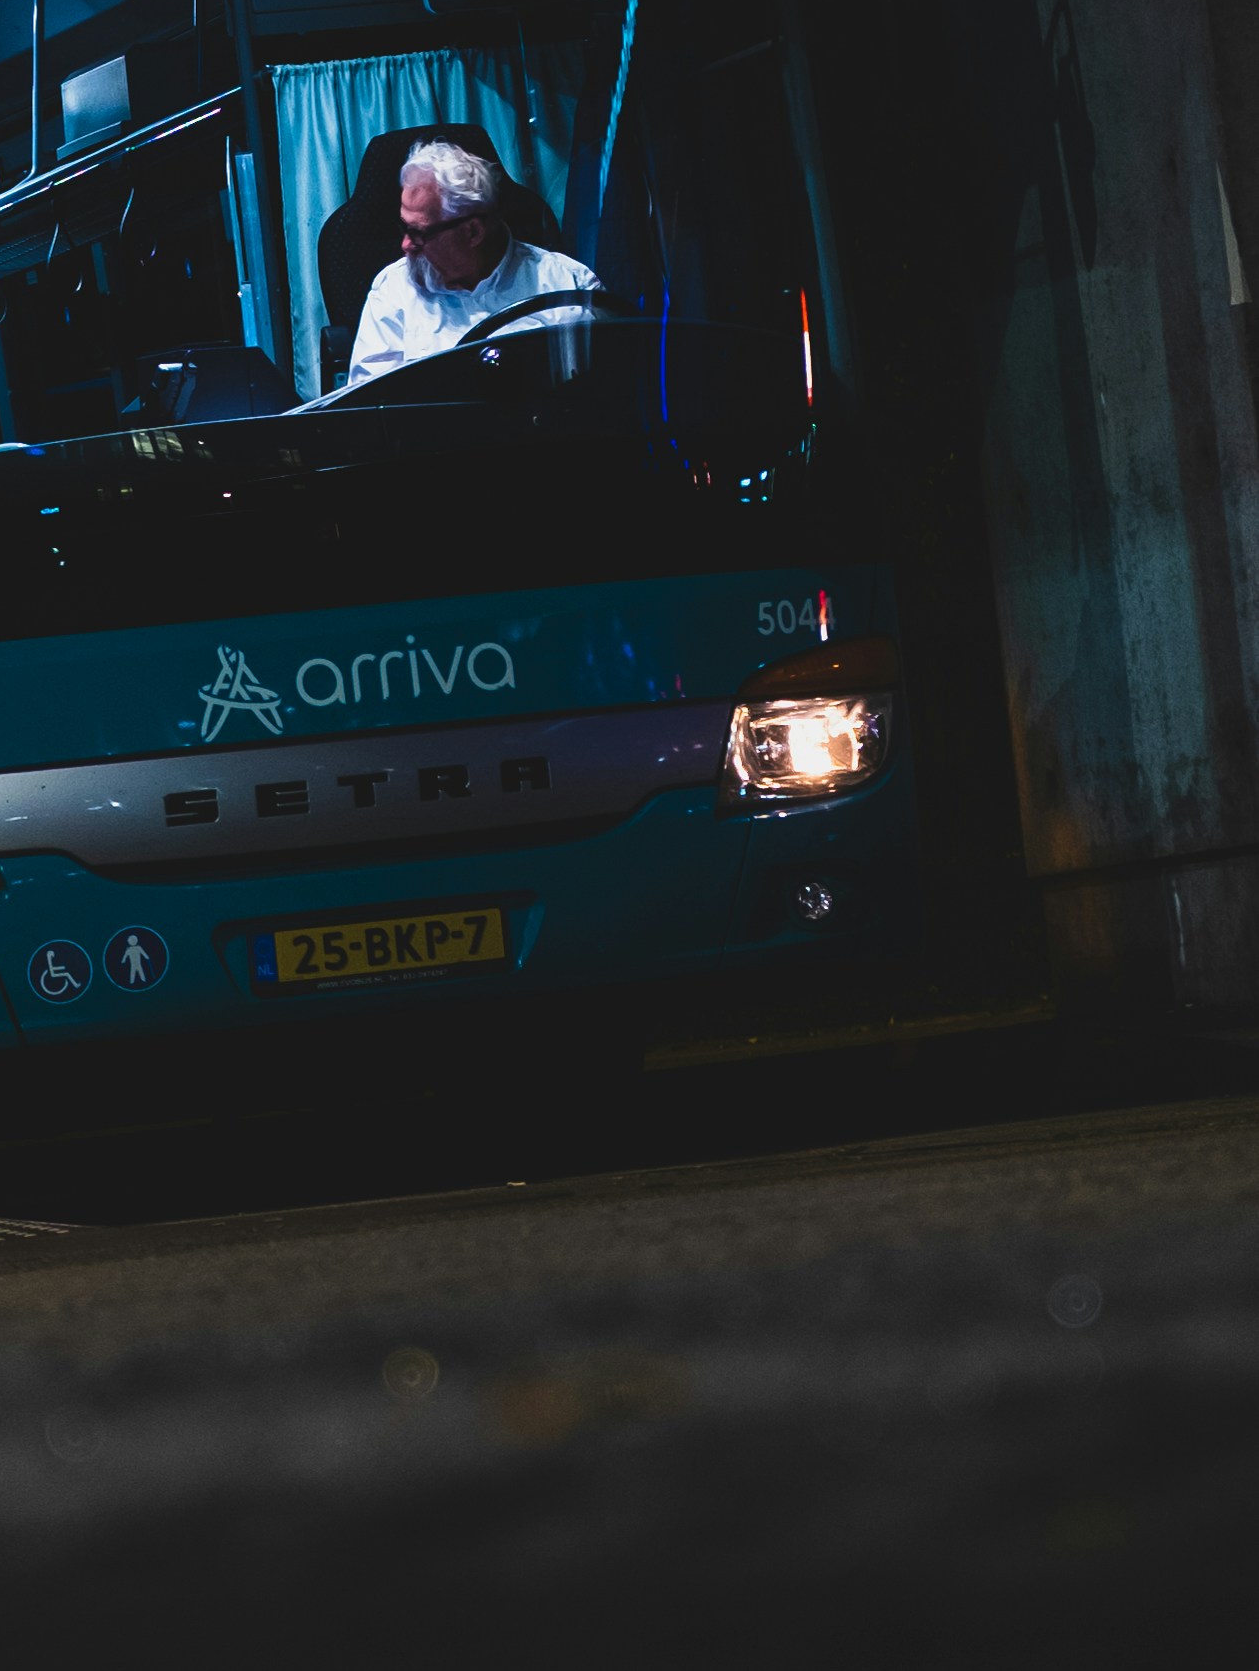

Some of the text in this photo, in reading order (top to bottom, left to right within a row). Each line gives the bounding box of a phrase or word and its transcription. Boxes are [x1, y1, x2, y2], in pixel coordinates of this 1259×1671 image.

[297, 634, 516, 707] arriva
[164, 756, 552, 827] SETRA
[257, 915, 488, 977] NL 25-BKP-7
